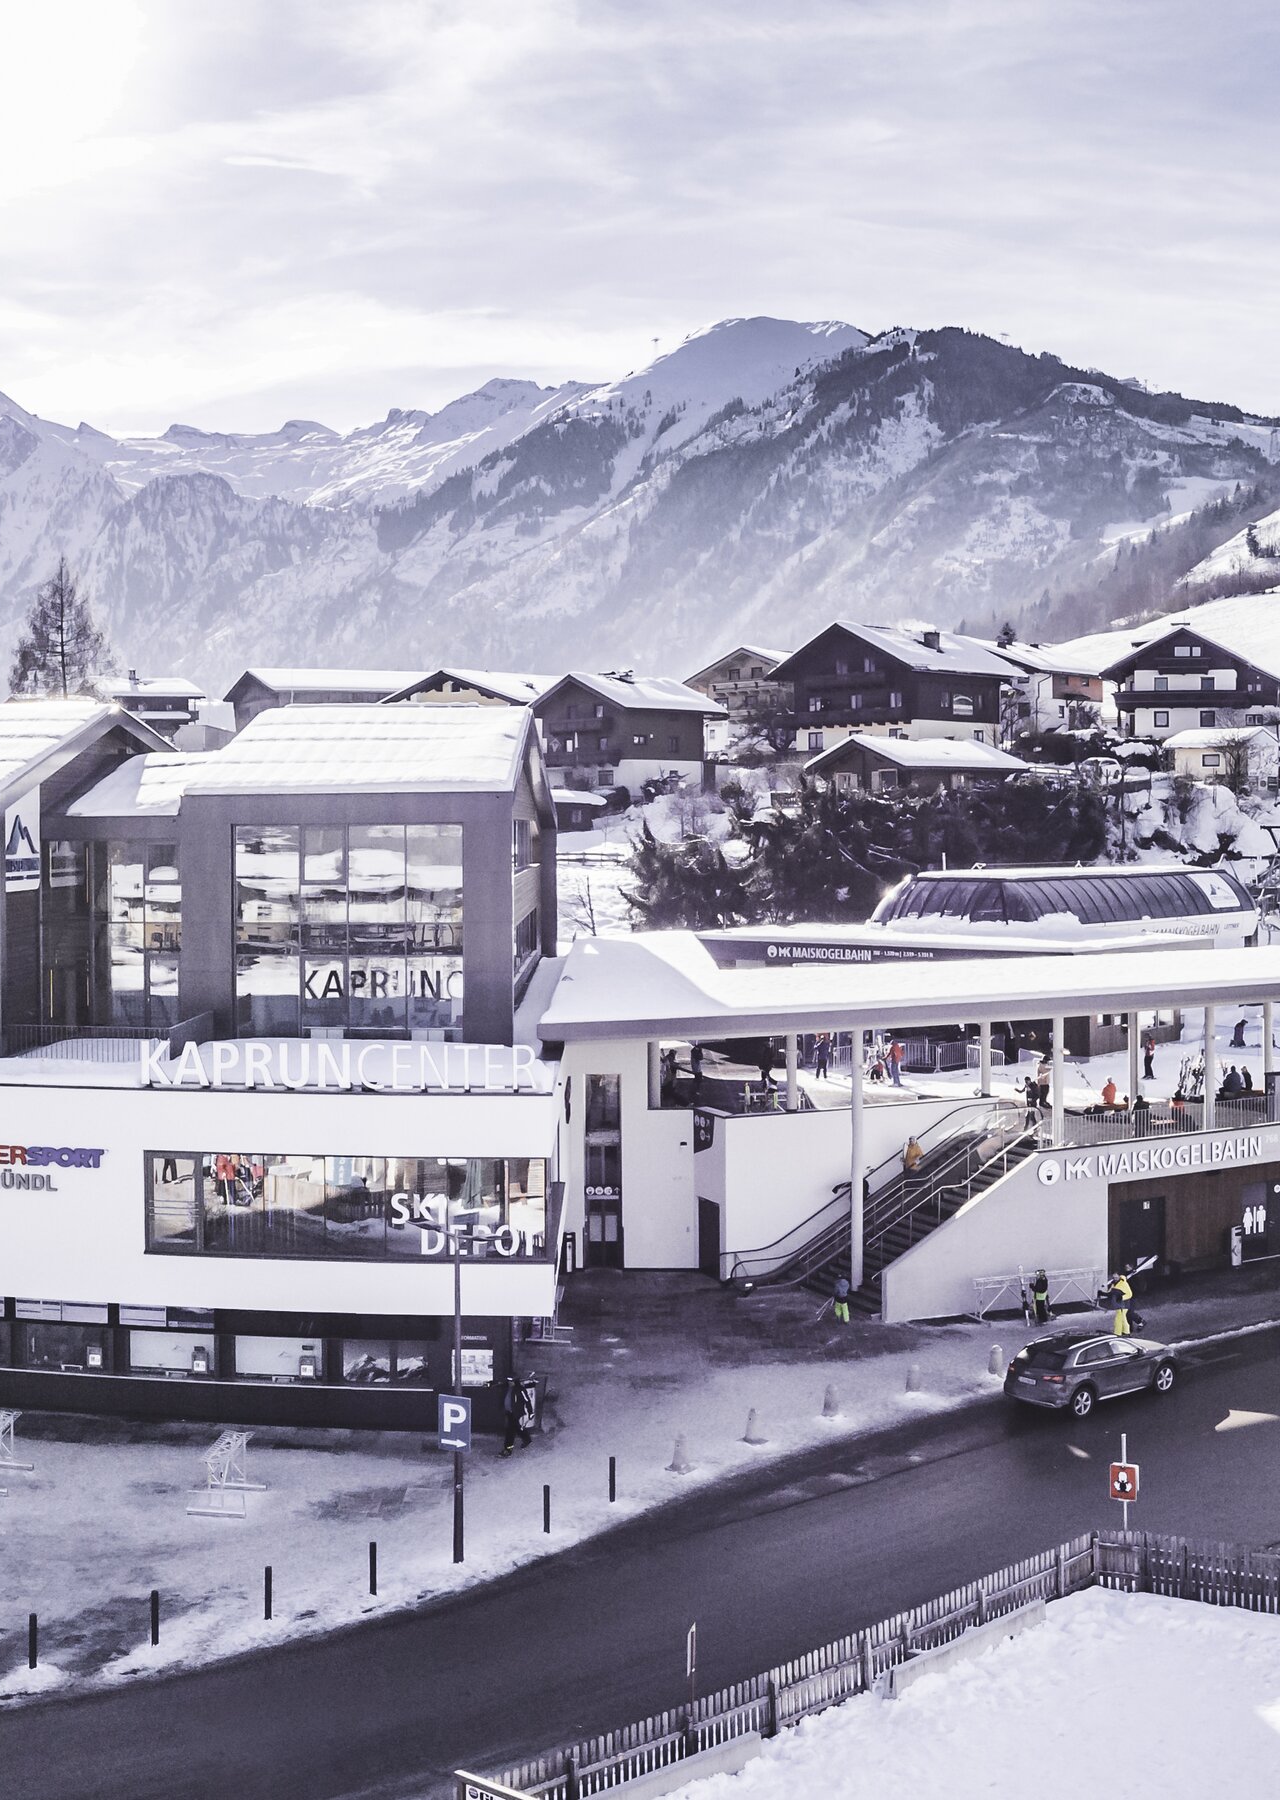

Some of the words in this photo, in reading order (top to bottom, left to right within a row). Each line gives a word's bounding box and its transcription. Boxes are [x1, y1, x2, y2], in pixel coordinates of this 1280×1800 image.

[792, 946, 871, 961] MAISKOGELBAHN
[140, 1040, 538, 1091] KAPRUNCENTER
[1064, 1156, 1092, 1181] MK
[1097, 1135, 1263, 1177] MAISKOGELBAHN
[390, 1192, 449, 1225] SKI
[443, 1402, 467, 1433] P
